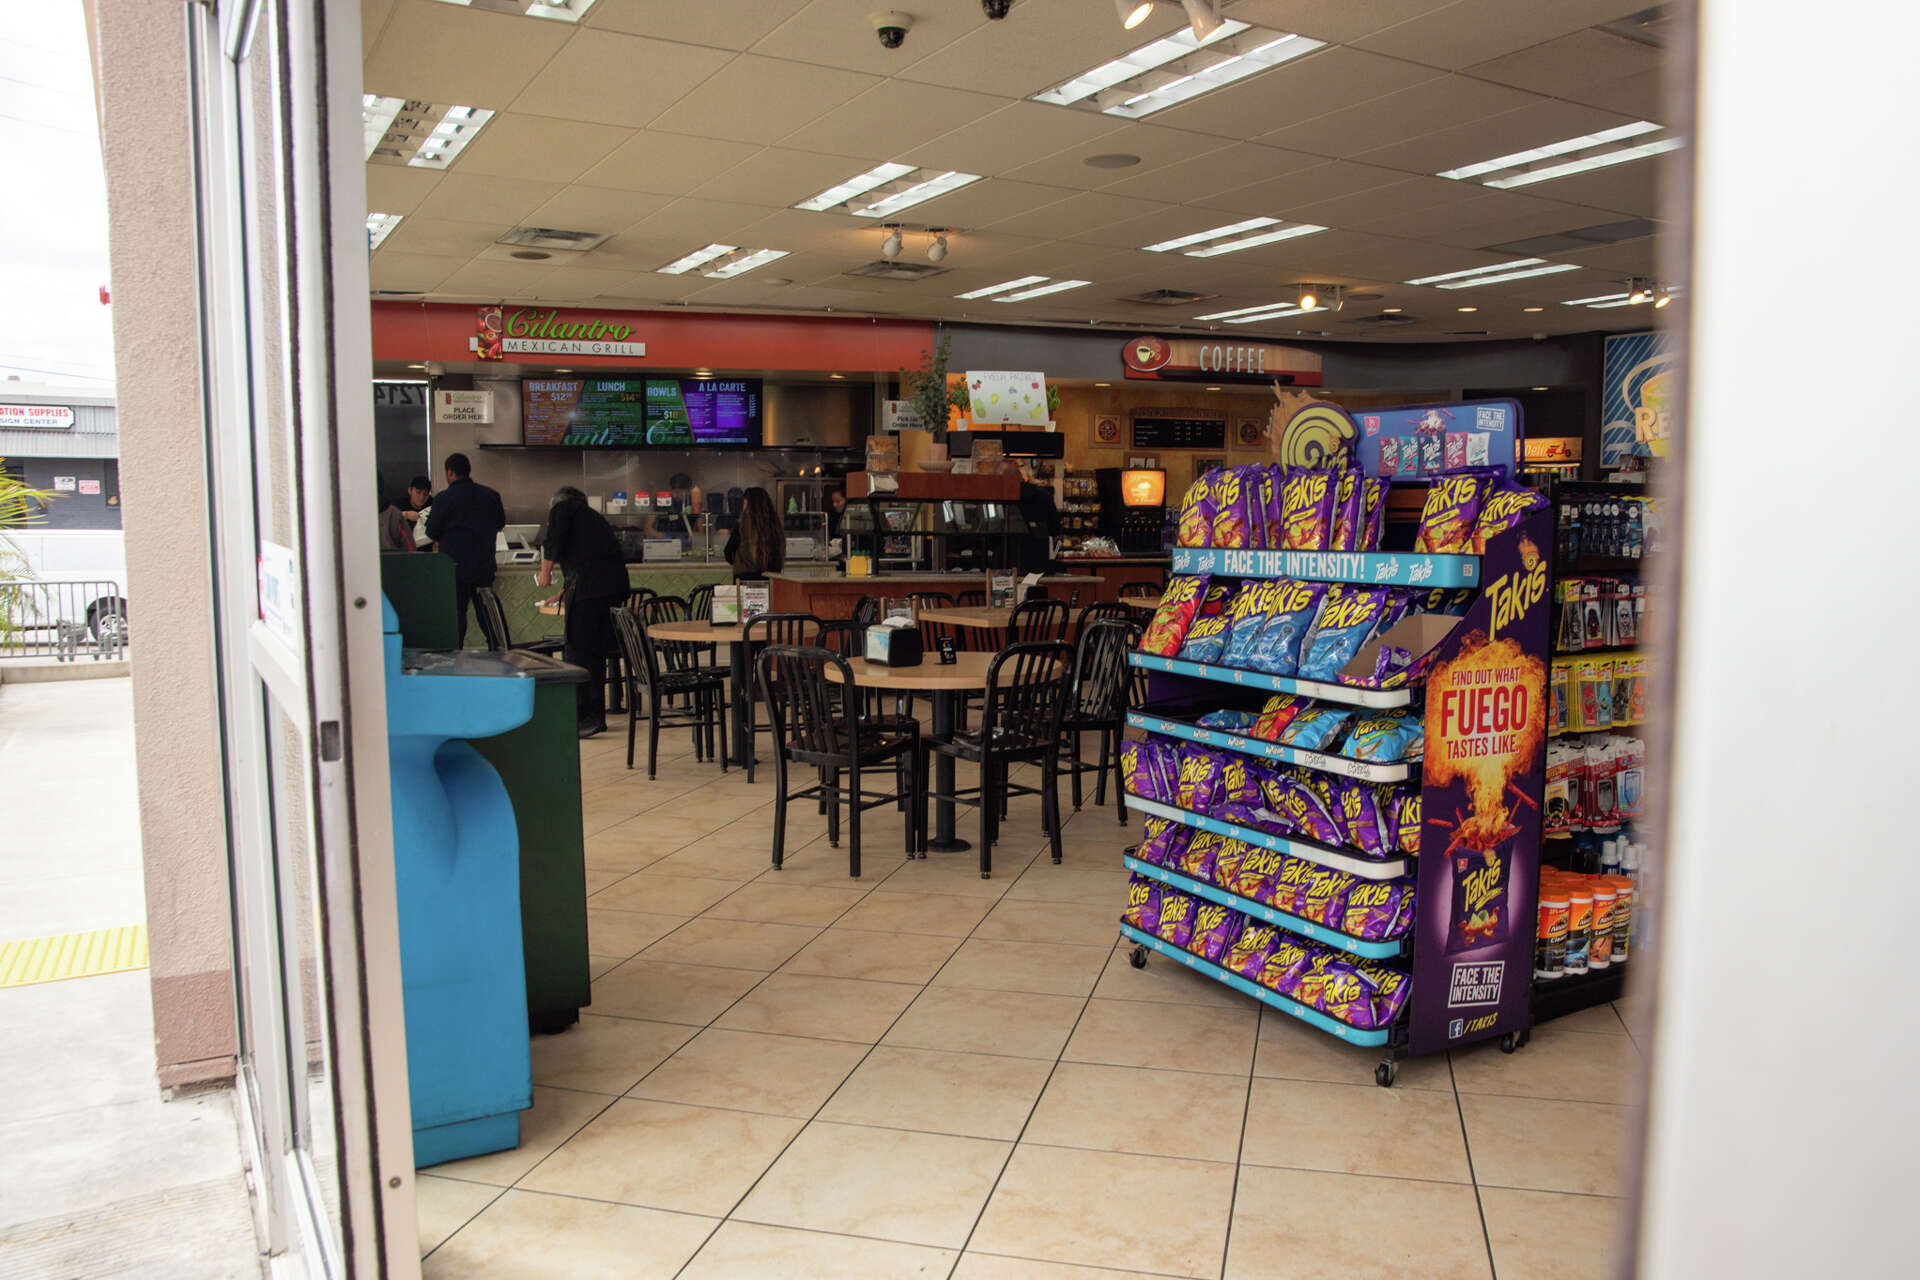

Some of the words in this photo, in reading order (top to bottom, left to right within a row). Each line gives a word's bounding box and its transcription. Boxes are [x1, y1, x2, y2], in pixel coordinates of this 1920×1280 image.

[507, 308, 636, 341] Cilantro
[507, 341, 582, 352] MEXICAN
[591, 343, 634, 354] GRILL
[1200, 345, 1265, 374] COFFEE
[528, 382, 577, 392] BREAKFAST
[597, 381, 626, 392] LUNCH
[647, 387, 677, 397] BOWLS
[698, 382, 705, 392] A
[707, 382, 717, 392] LA
[719, 382, 746, 392] CARTE
[28, 408, 69, 417] SUPPLIES
[1224, 550, 1254, 574] FACE
[1257, 551, 1282, 575] THE
[1286, 552, 1365, 580] INTENSITY!
[1452, 670, 1473, 687] FIND
[1475, 669, 1493, 685] OUT
[1495, 667, 1521, 683] WHAT
[1440, 684, 1528, 738] FUEGO
[1446, 737, 1489, 760] TASTES
[1454, 968, 1480, 985] FACE
[1482, 966, 1502, 984] THE
[1452, 984, 1499, 1002] INTENSITY
